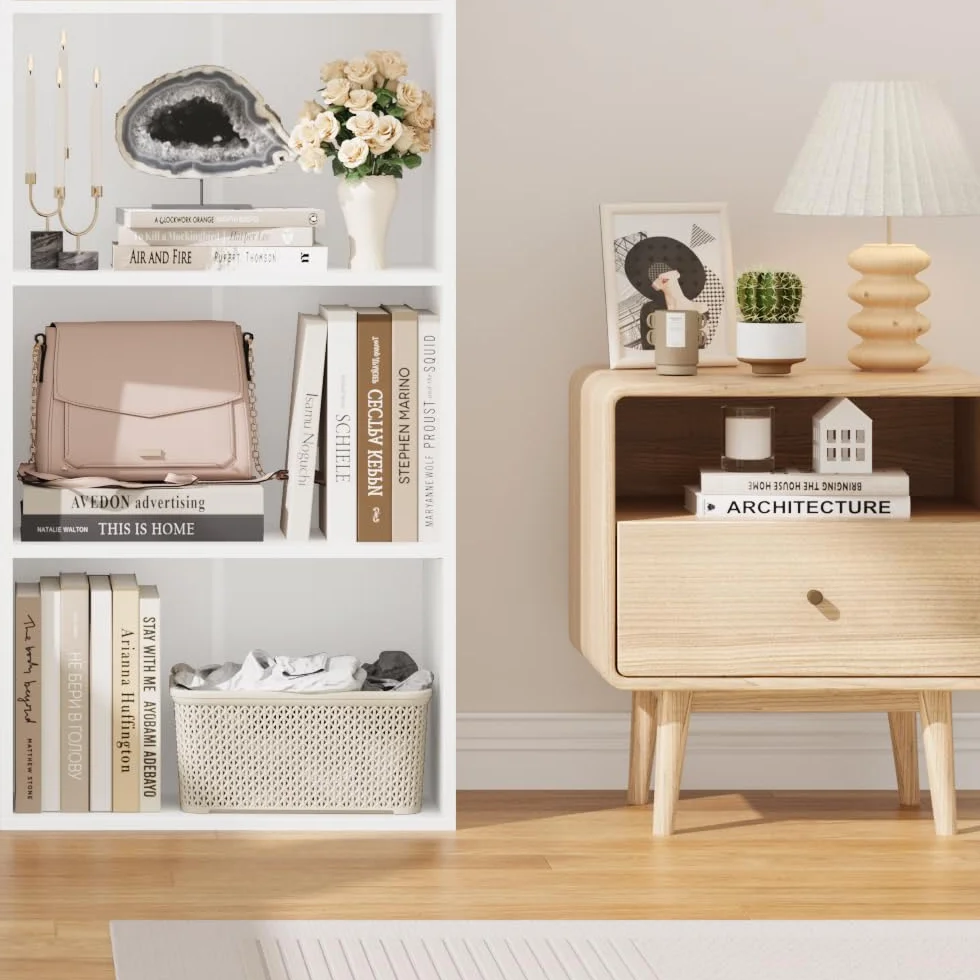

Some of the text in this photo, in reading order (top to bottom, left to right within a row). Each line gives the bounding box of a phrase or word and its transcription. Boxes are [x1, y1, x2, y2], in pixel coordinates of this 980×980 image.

[159, 216, 192, 225] CLOCKWORK
[192, 216, 215, 224] ORANGE
[398, 367, 411, 484] STEPHEN MARINO
[423, 334, 436, 449] PROUST SQUID
[297, 392, 320, 486] Isamu Noguchi
[335, 413, 351, 483] SCHIELE
[71, 494, 206, 512] AVEDON advertising
[424, 455, 434, 527] MARYANNE WOLF
[726, 500, 892, 515] ARCHITECTURE
[748, 480, 862, 492] BRINGING THE HOUSE HOME
[97, 522, 196, 536] THIS IS HOME
[17, 613, 39, 724] The body beyond
[116, 628, 136, 774] Arianna Huffington
[142, 616, 157, 798] STAY WITH ME AYOBAMI ADEBAYO
[67, 651, 82, 781] НЕ БЕРИ В ГОЛОВУ
